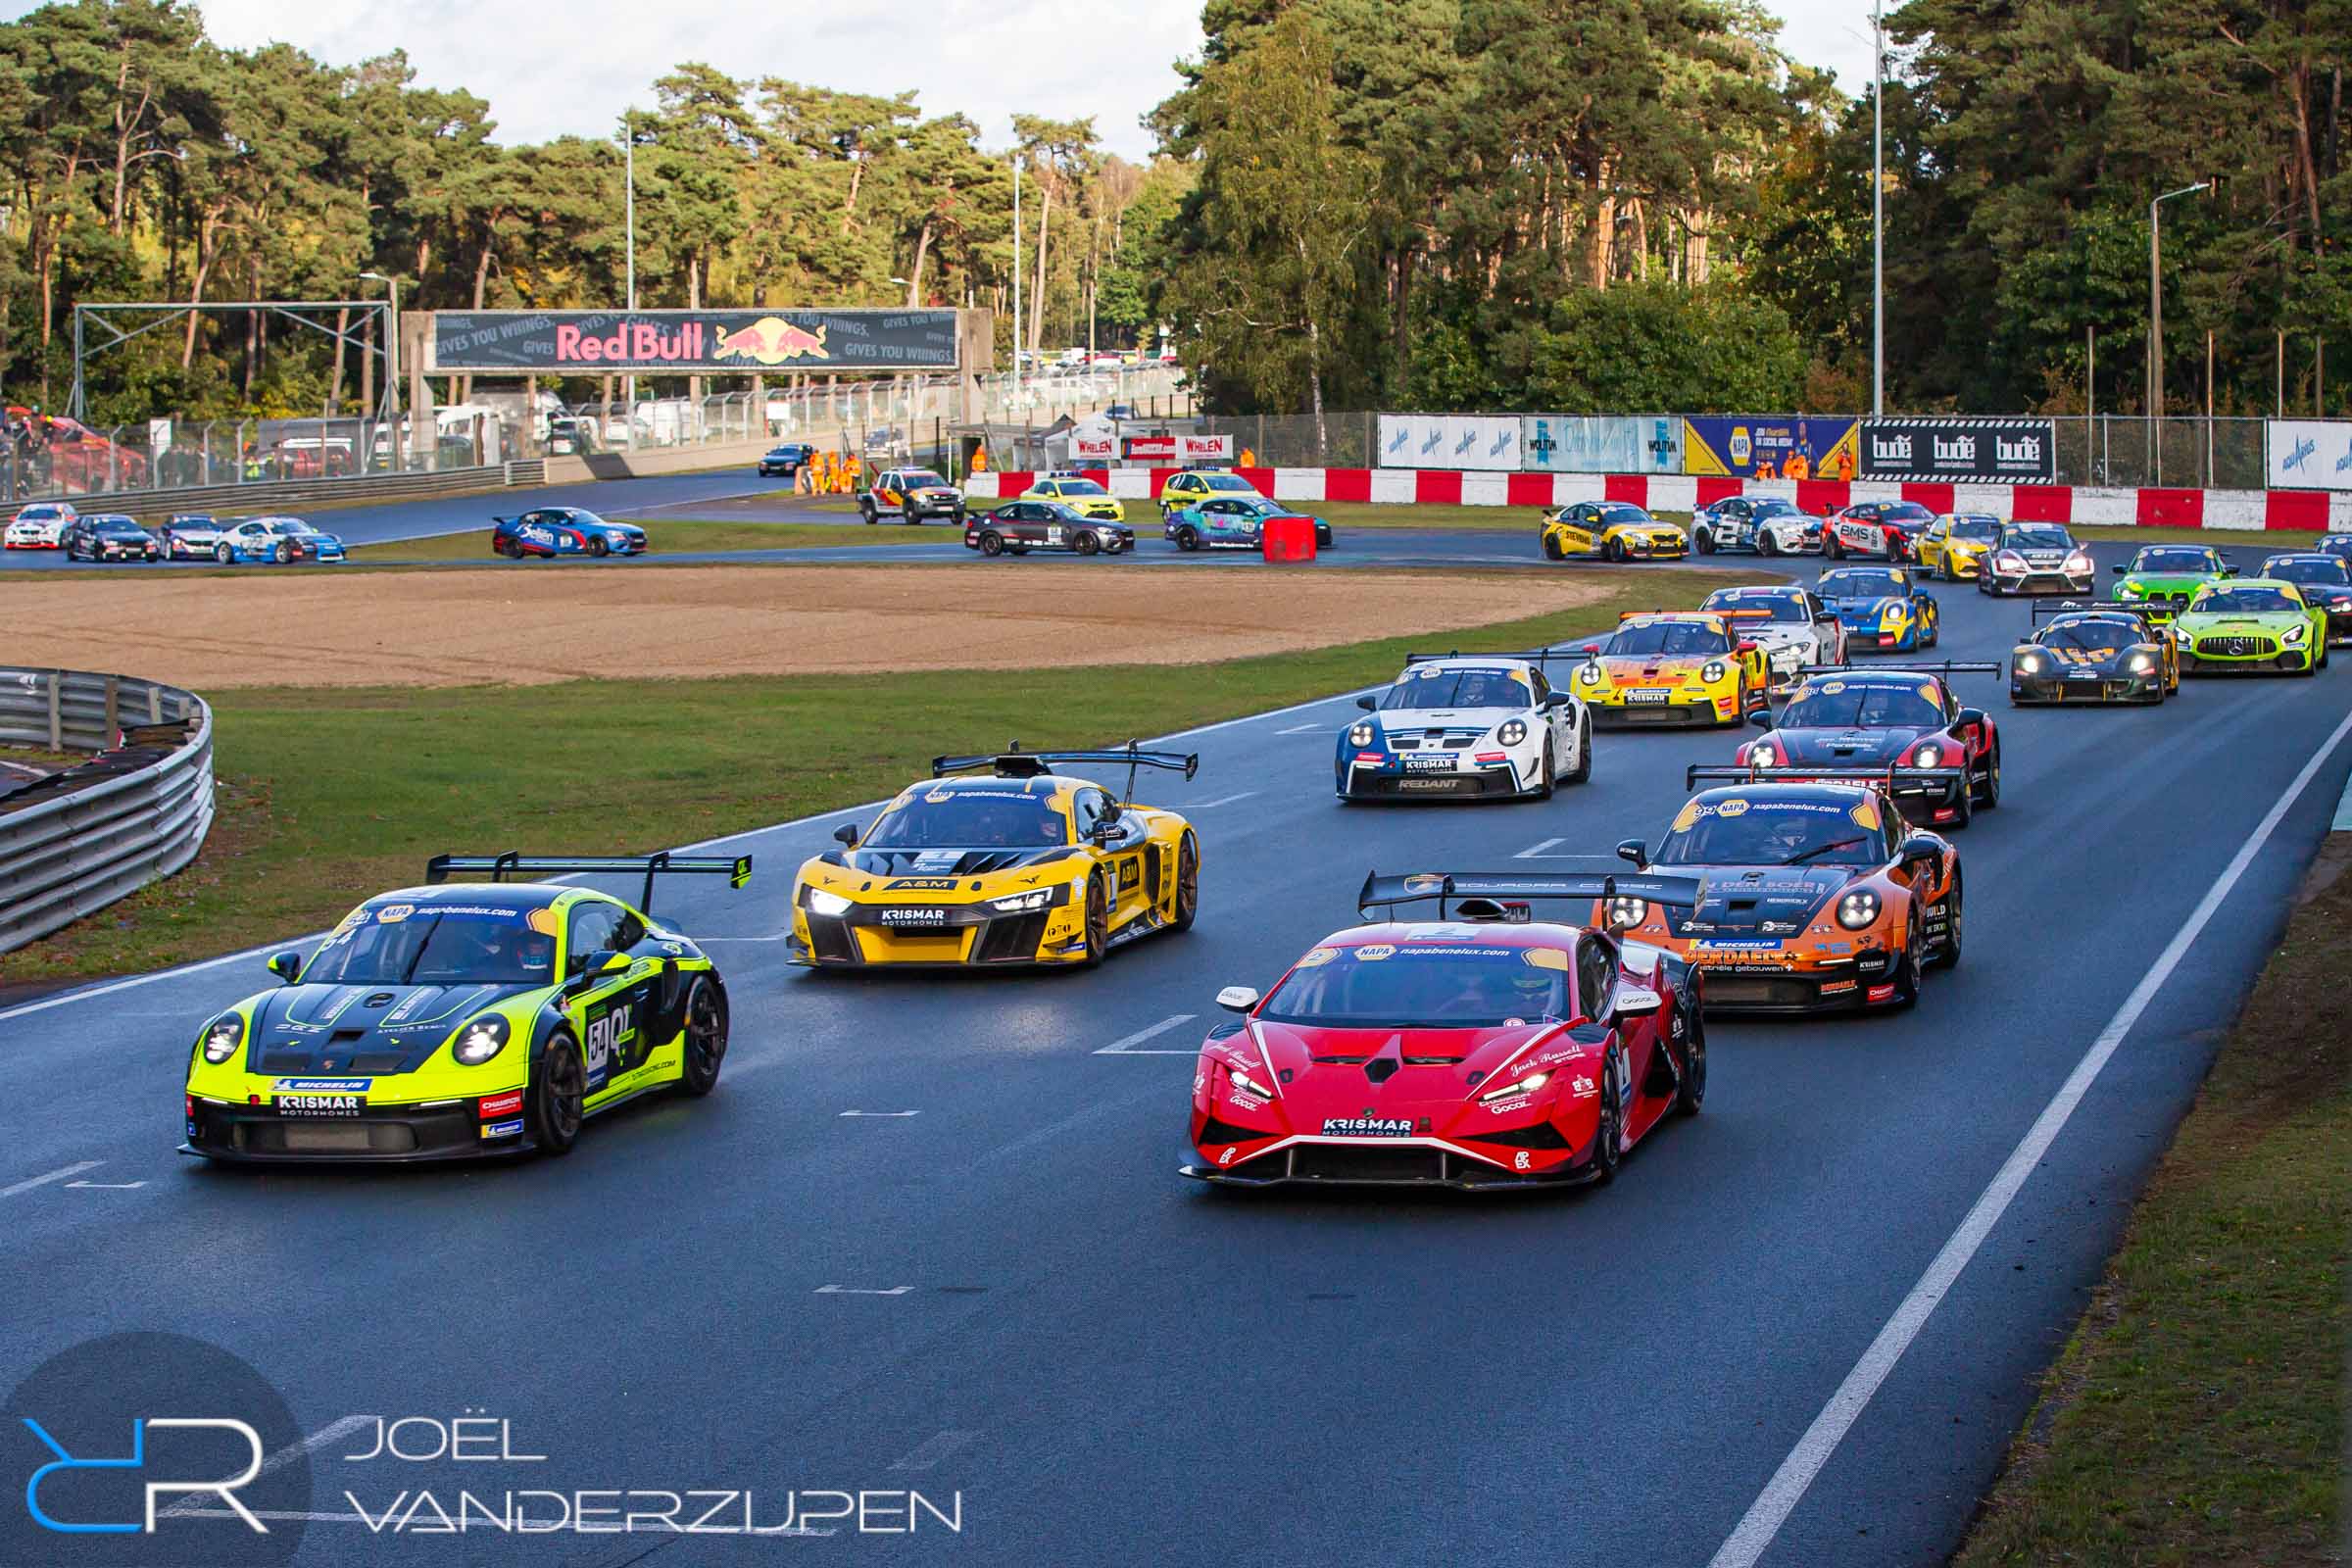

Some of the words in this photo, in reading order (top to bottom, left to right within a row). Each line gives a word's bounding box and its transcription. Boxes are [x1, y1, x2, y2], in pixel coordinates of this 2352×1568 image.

[557, 323, 627, 361] Red
[633, 322, 703, 361] Bull
[845, 343, 878, 358] GIVES
[880, 345, 905, 360] YOU
[1186, 437, 1223, 453] WHELEN
[1733, 438, 1748, 455] NAPA
[1406, 760, 1451, 769] KRISMAR
[1398, 779, 1460, 789] REDANT
[1721, 804, 1745, 812] NAPA
[1752, 803, 1840, 813] napabenelux.com
[383, 907, 409, 918] NAPA
[882, 909, 945, 920] KRISMAR
[1360, 947, 1390, 956] NAPA
[1399, 948, 1510, 956] napabenelux.com
[590, 1018, 607, 1061] 54
[1510, 1059, 1538, 1077] Jack
[1539, 1045, 1582, 1062] Russell
[279, 1097, 358, 1108] KRISMAR
[1323, 1118, 1412, 1131] KRISMAR
